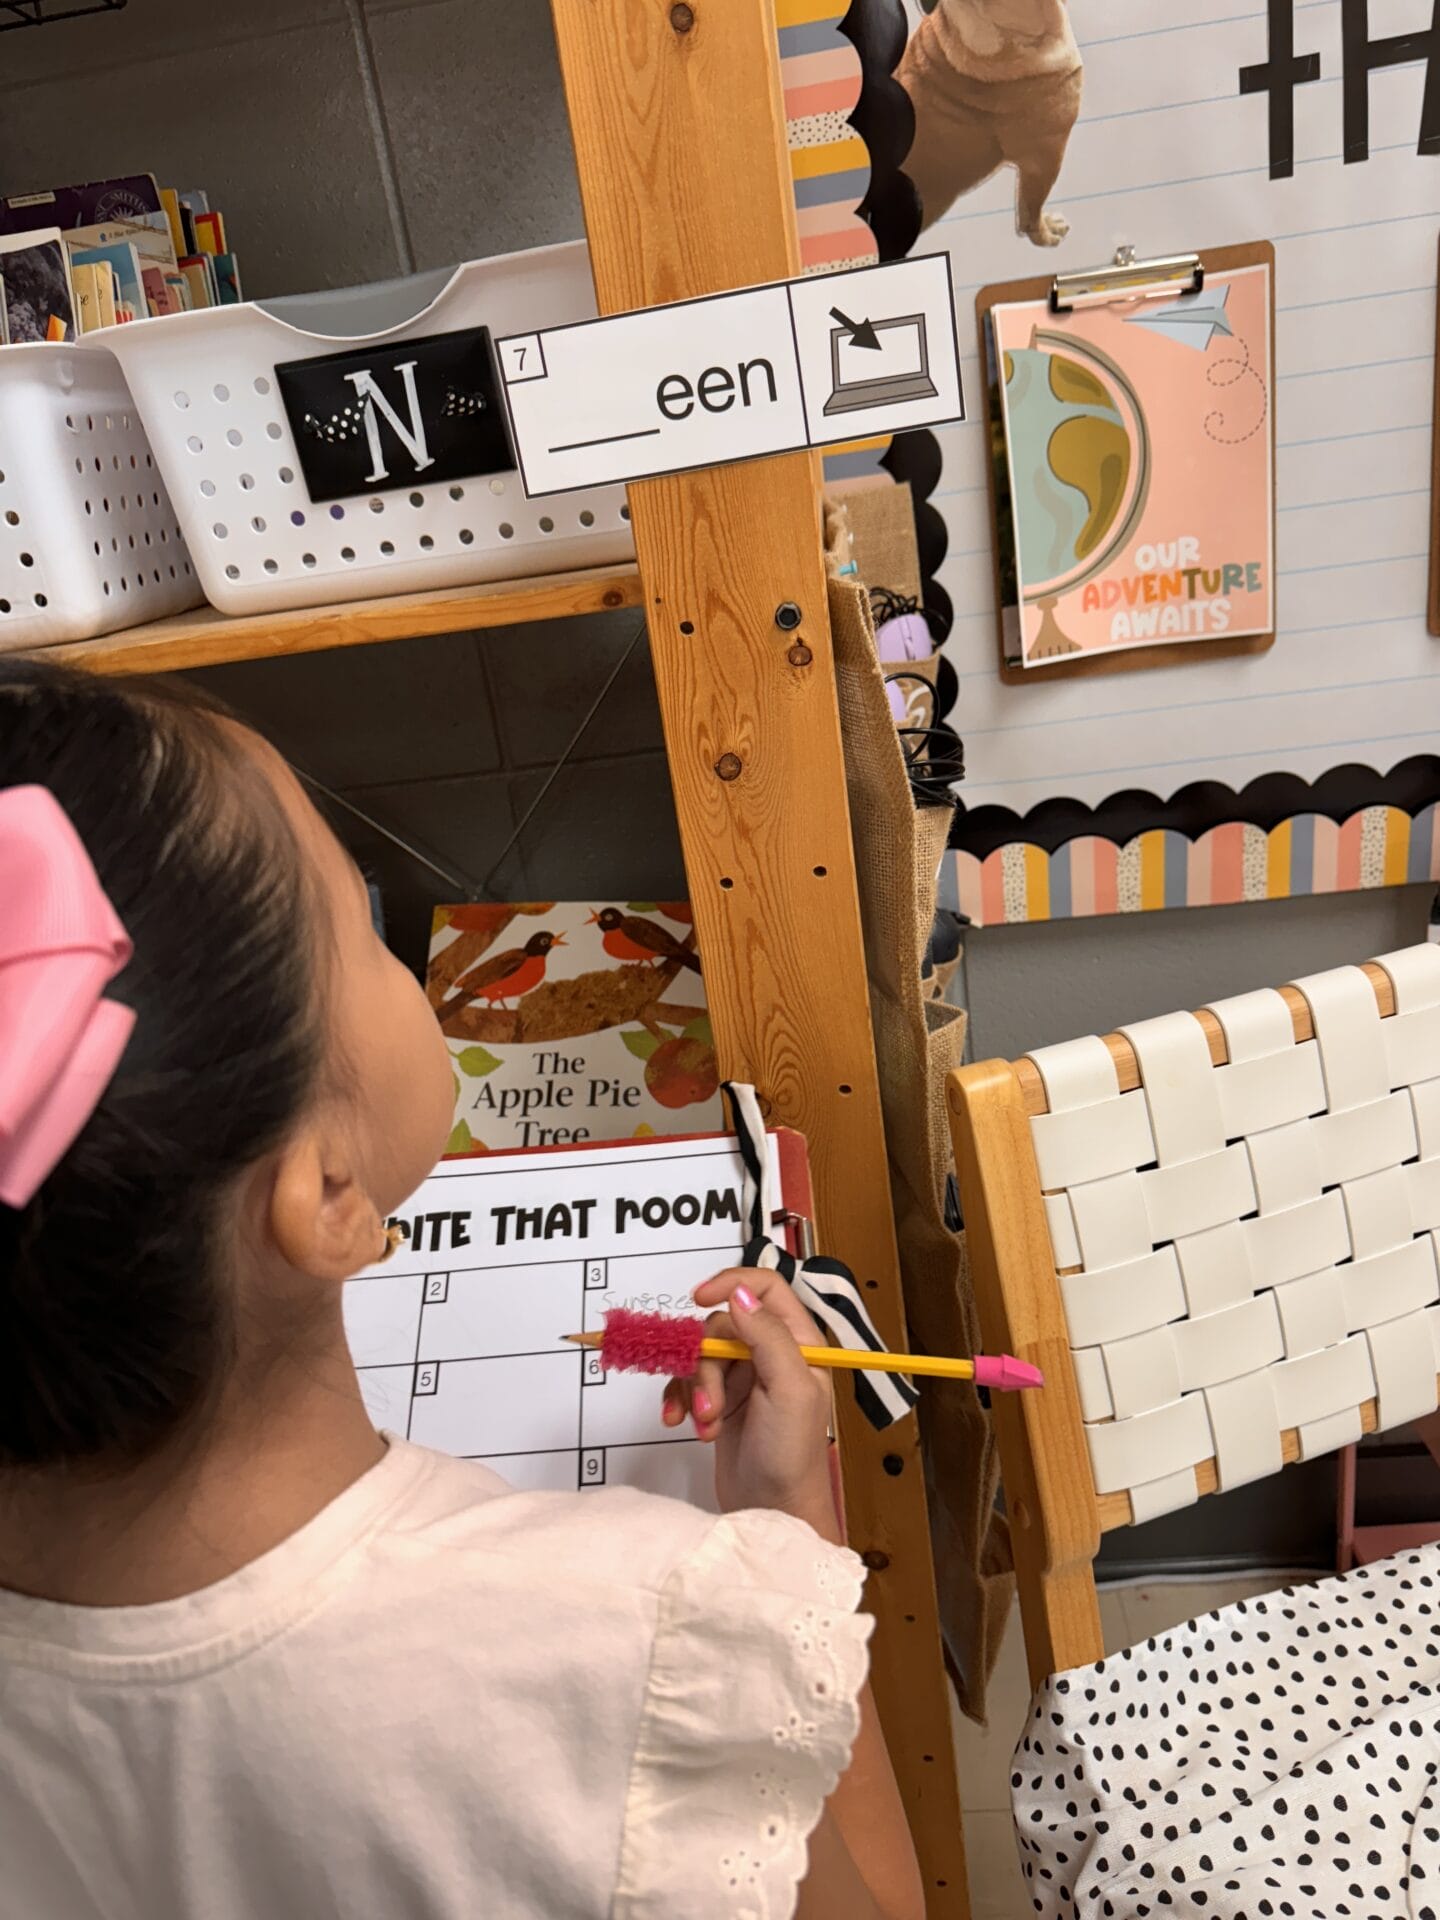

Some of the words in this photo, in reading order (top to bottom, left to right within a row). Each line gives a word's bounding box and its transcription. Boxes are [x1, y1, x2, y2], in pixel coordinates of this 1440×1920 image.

[513, 347, 527, 372] 7
[344, 360, 435, 483] N
[1135, 535, 1200, 572] OUR
[1082, 562, 1263, 613] ADVENTURE
[1110, 598, 1231, 642] AWAITS
[532, 1051, 586, 1075] The
[472, 1080, 574, 1118] Apple
[586, 1079, 642, 1108] Pie
[515, 1120, 590, 1148] Tree
[591, 1268, 602, 1282] 3
[430, 1281, 441, 1296] 2
[420, 1371, 432, 1387] 5
[588, 1359, 600, 1375] 6
[587, 1458, 599, 1476] 9
